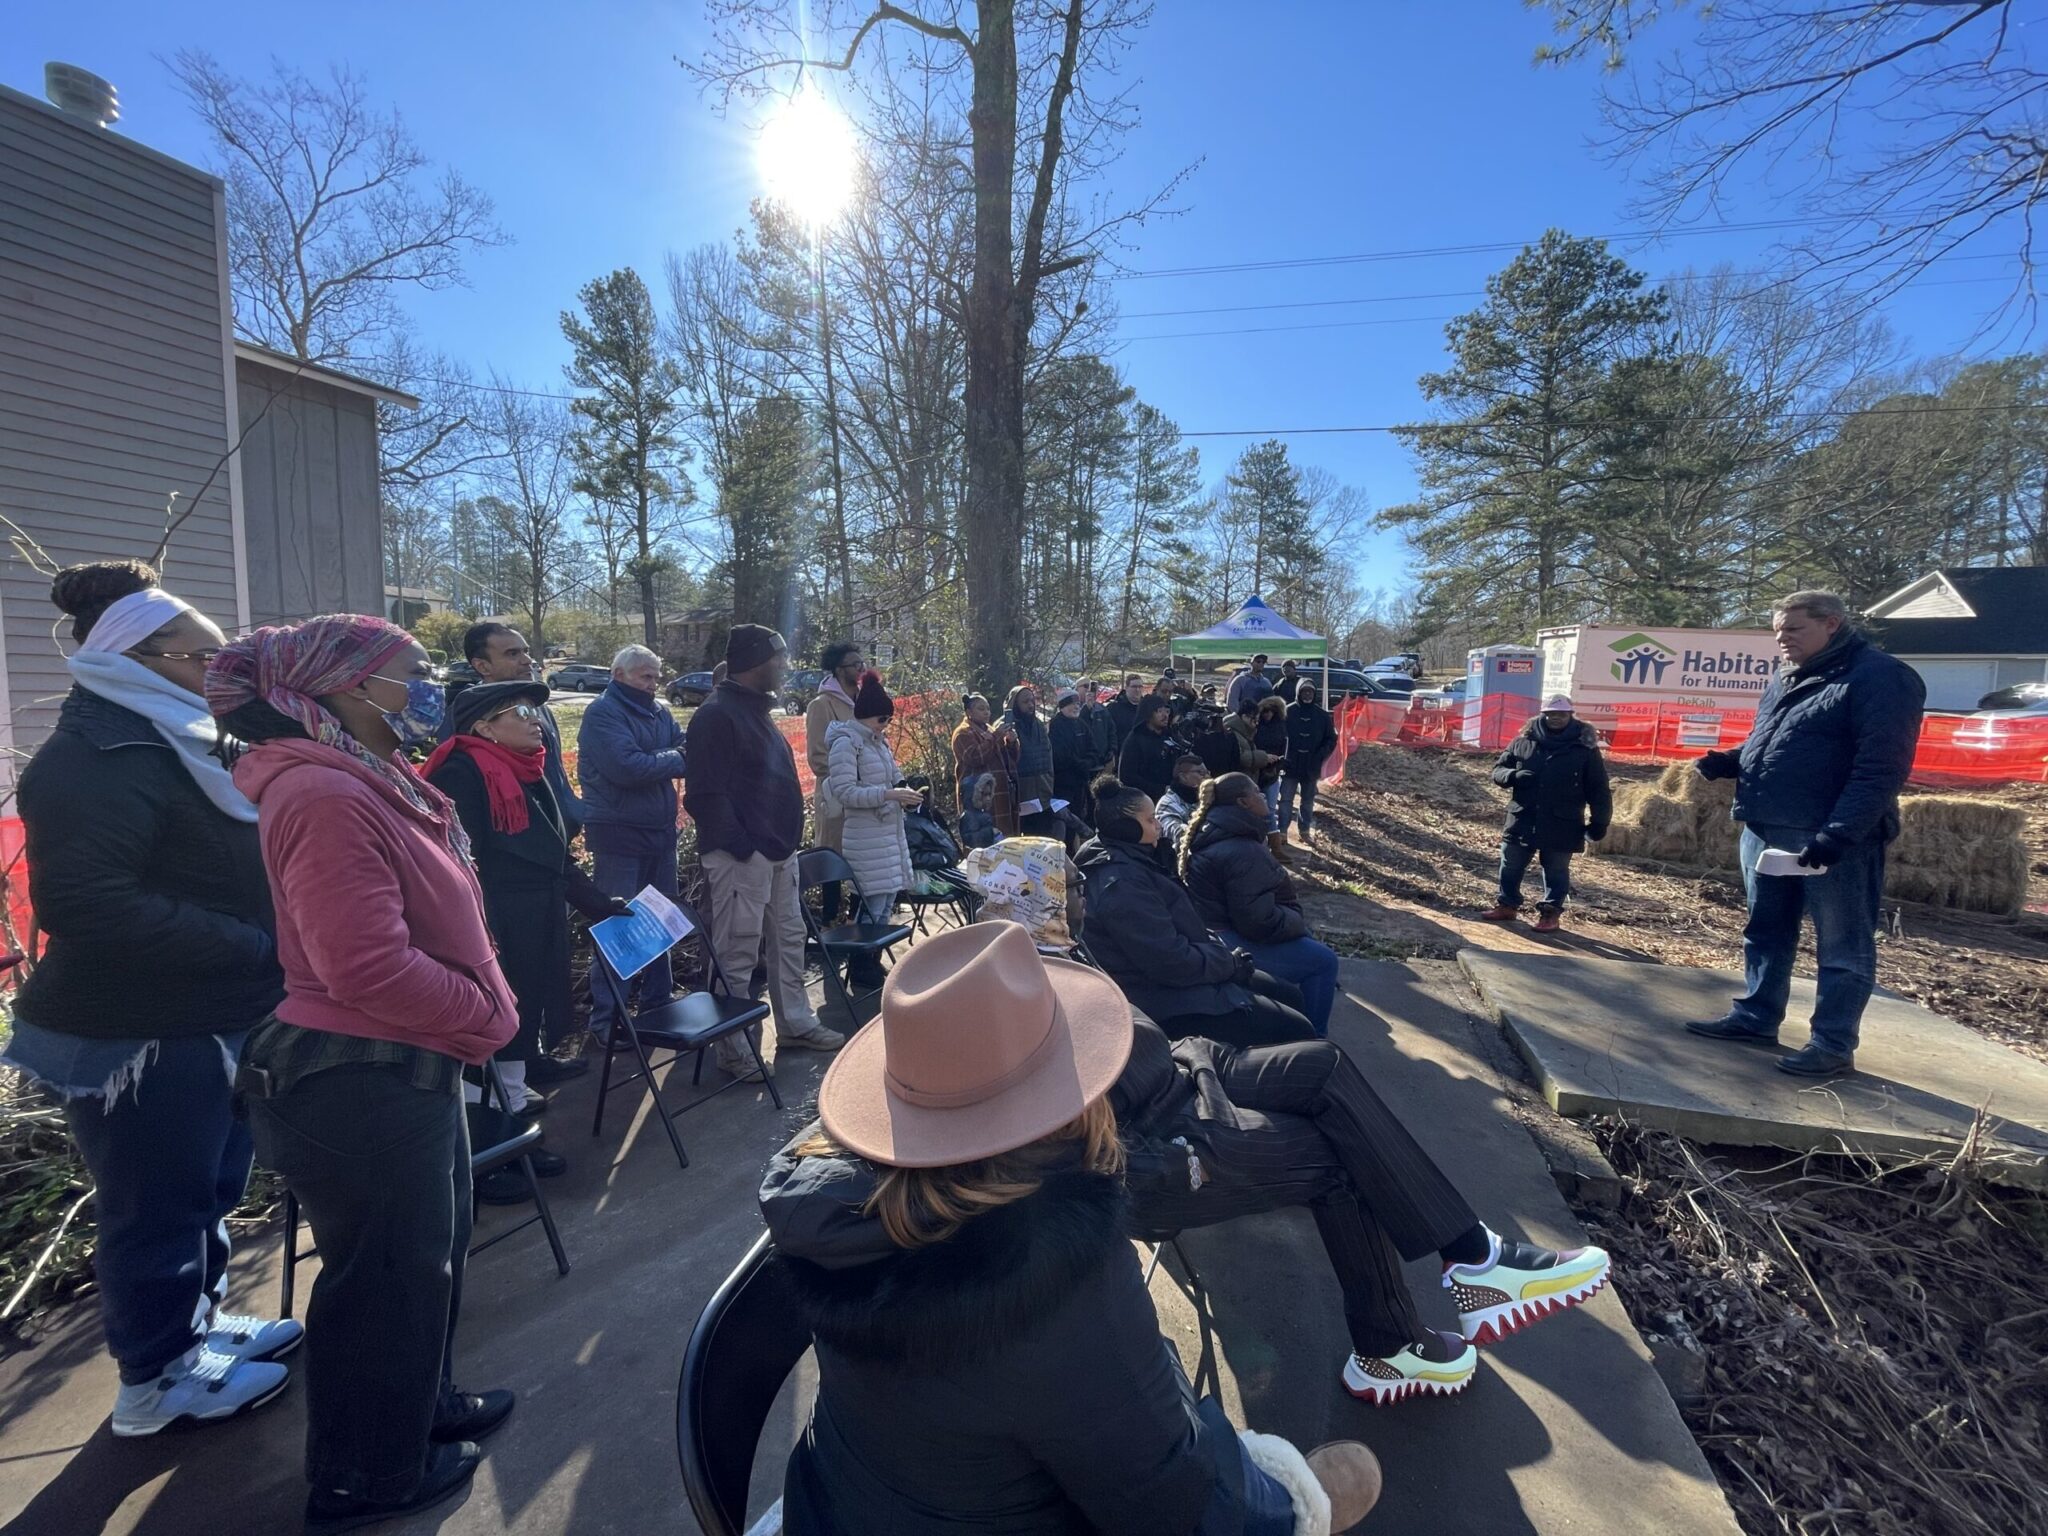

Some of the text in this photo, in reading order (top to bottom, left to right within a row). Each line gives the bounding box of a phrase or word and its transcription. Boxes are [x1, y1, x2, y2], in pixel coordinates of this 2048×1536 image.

[1682, 650, 1781, 676] Habitat
[1681, 674, 1770, 690] for Humanit
[1678, 696, 1717, 708] DeKalb
[1031, 851, 1060, 870] SUDAN
